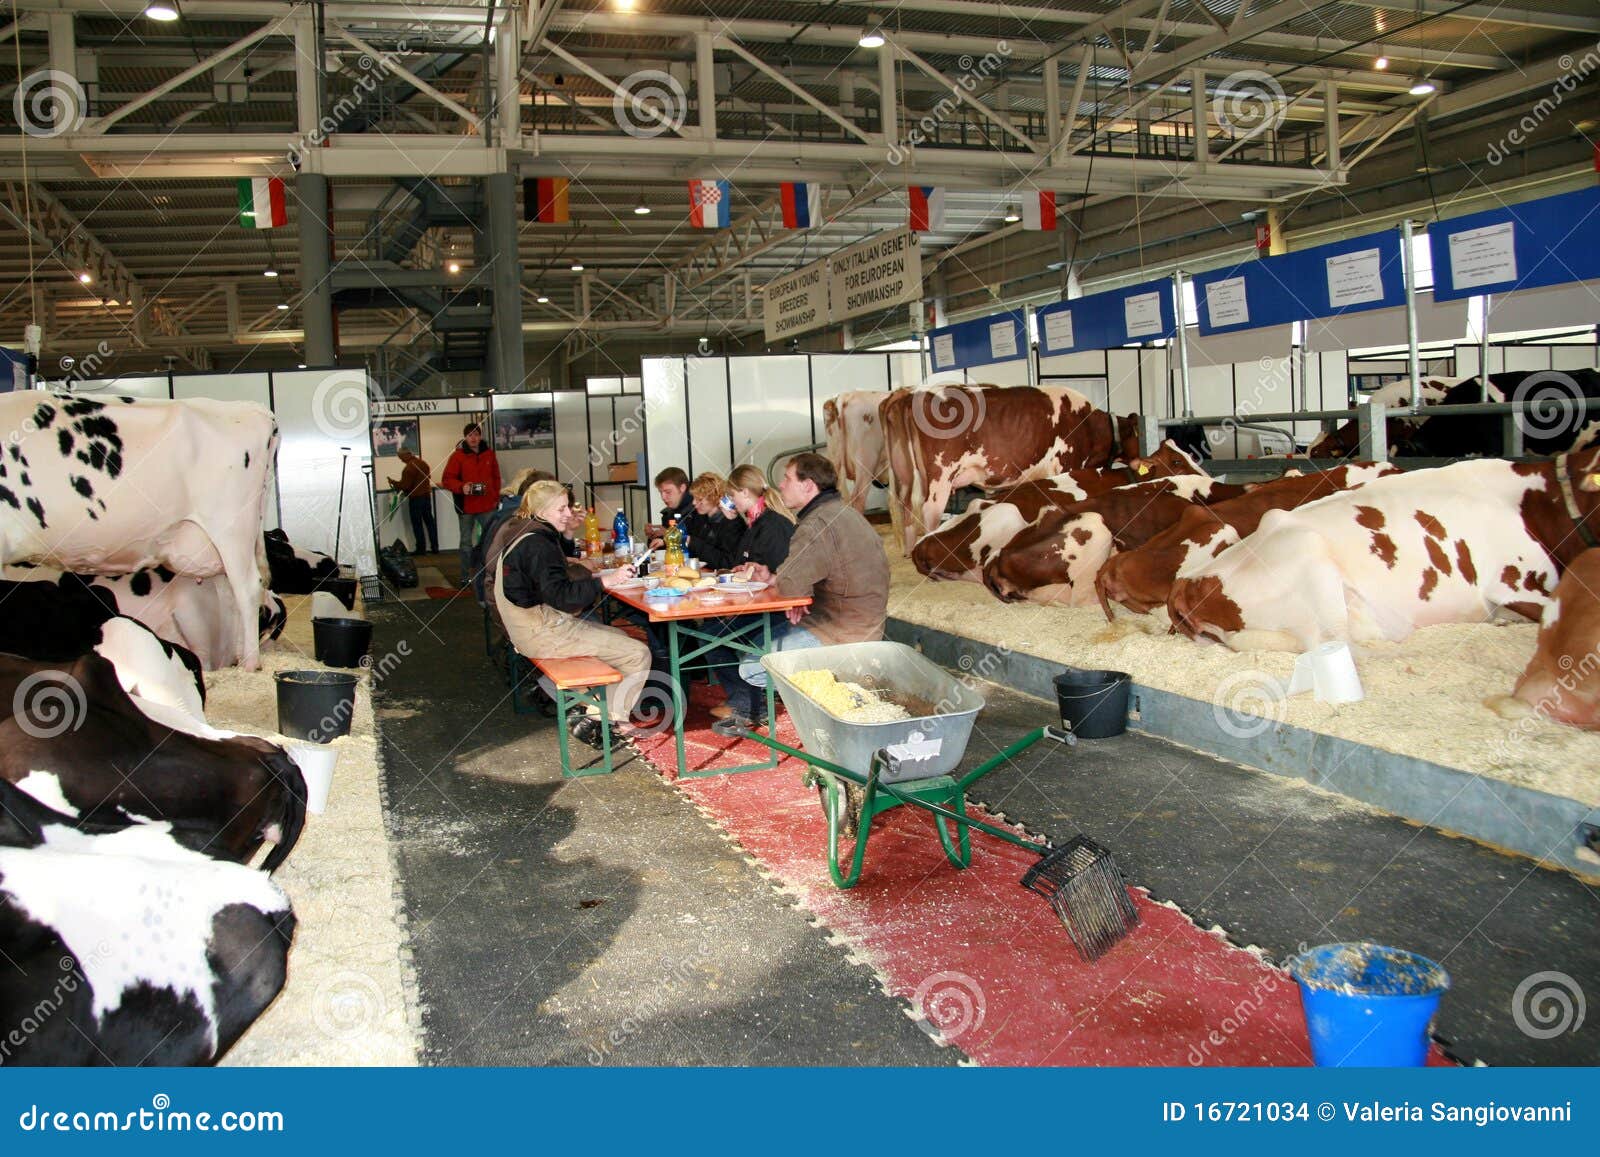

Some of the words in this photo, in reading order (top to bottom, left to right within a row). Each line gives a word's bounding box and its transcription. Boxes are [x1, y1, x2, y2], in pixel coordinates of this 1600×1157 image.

[832, 257, 851, 275] ONLY
[851, 246, 880, 268] ITALIAN
[881, 231, 918, 256] GENETIC
[769, 279, 798, 300] EUROPEAN
[799, 269, 820, 287] YOUNG
[845, 274, 860, 291] FOR
[861, 258, 904, 286] EUROPEAN
[847, 280, 903, 310] SHOWMANSHIP
[775, 309, 816, 333] SHOWMANSHIP
[377, 400, 439, 413] HUNGARY
